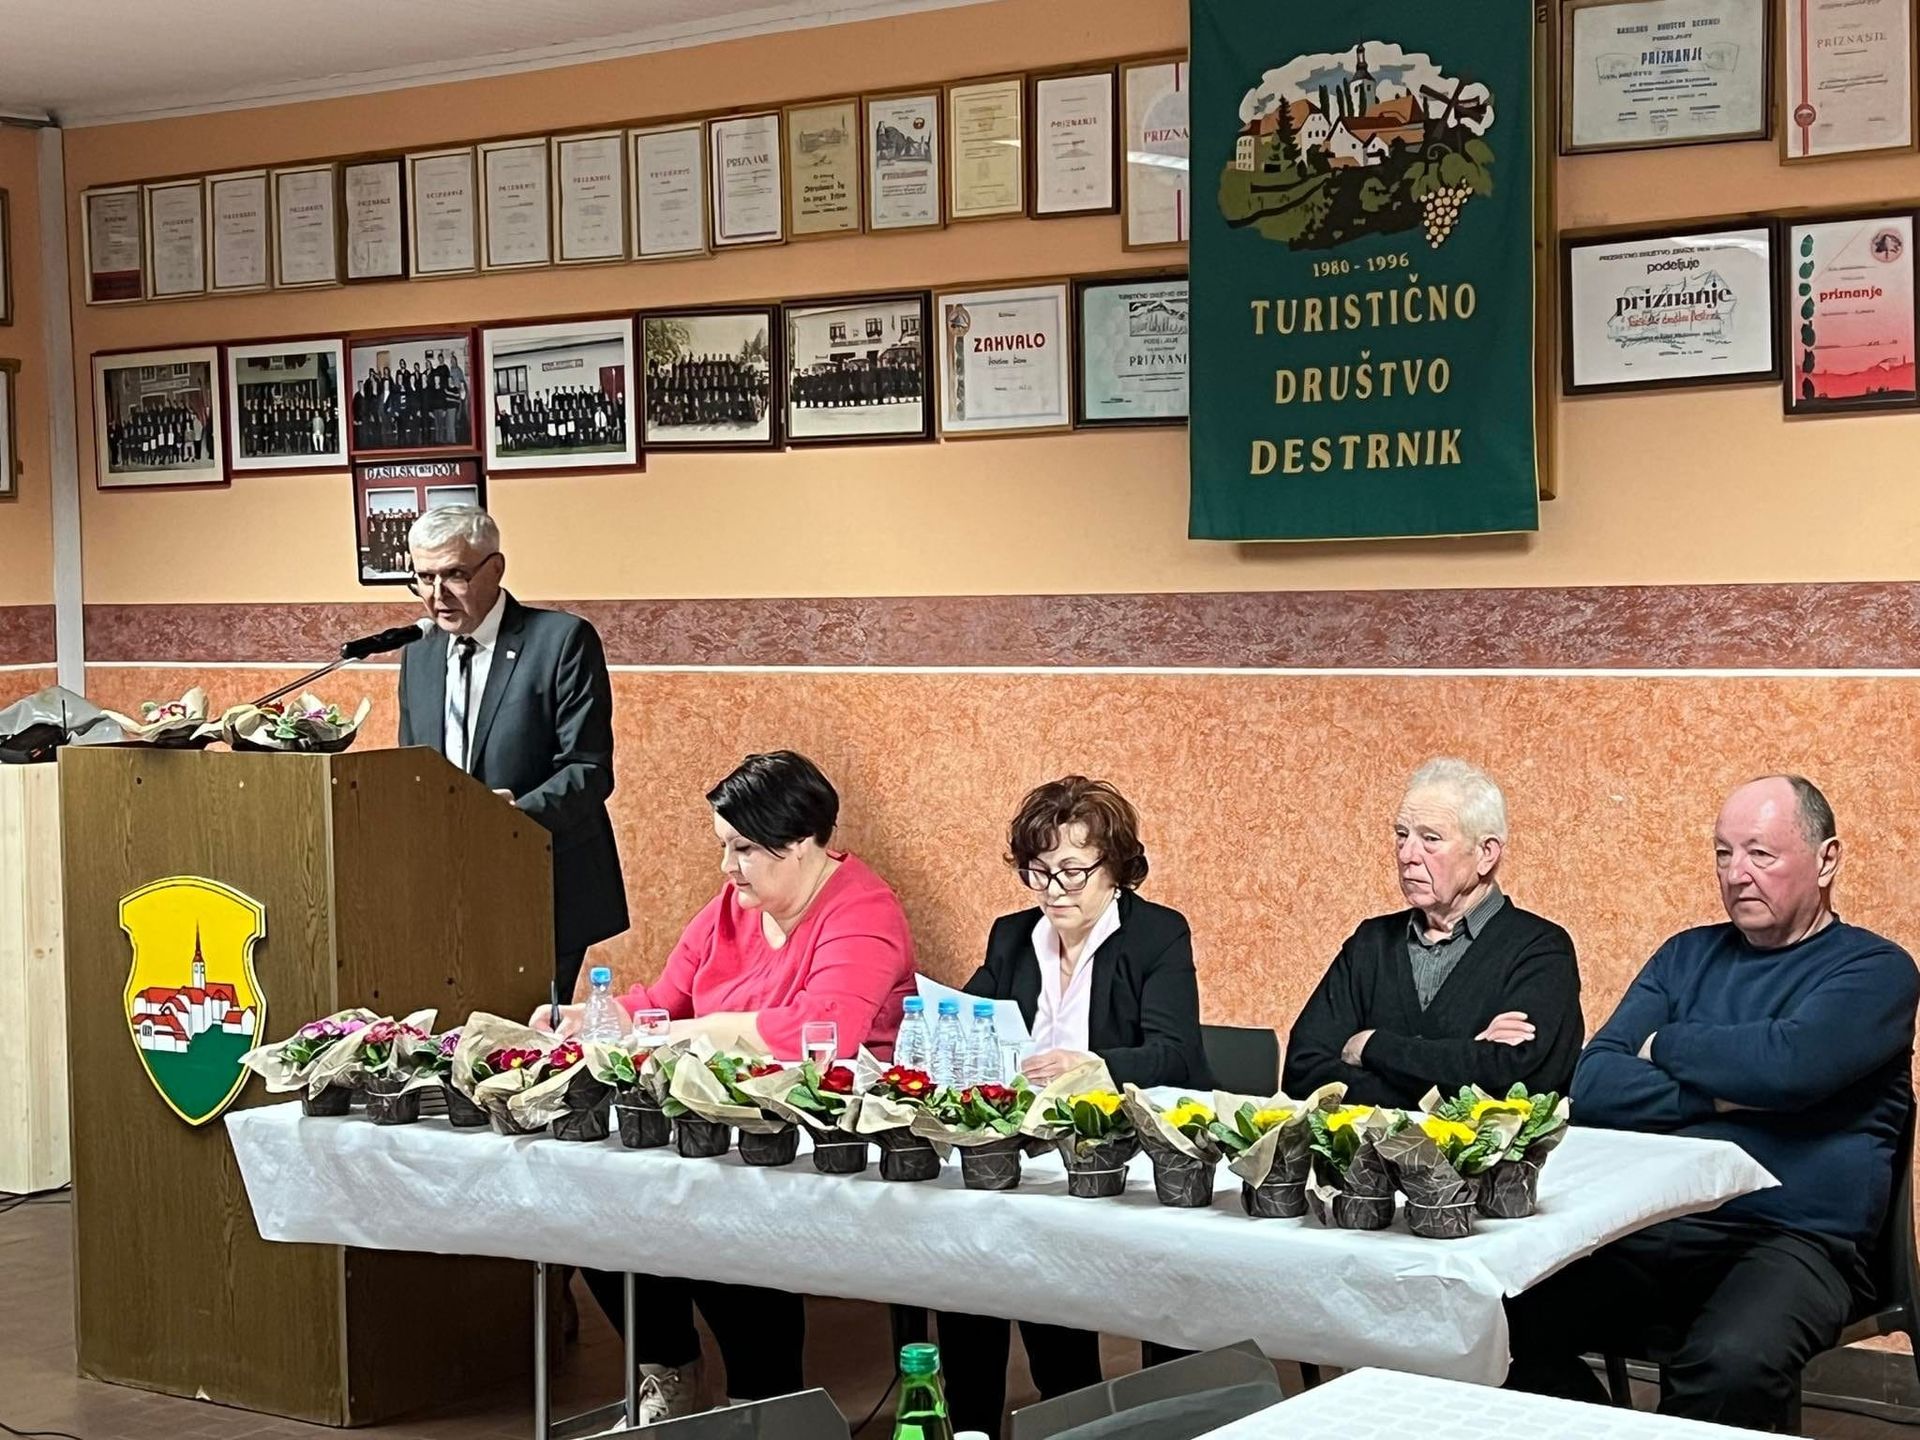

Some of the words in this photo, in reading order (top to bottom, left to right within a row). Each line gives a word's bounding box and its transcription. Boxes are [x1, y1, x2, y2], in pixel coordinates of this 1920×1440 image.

[1816, 31, 1888, 49] PRIZNANJE
[1641, 47, 1703, 66] PRIZNANJE
[1312, 258, 1350, 278] 1980
[1366, 252, 1410, 272] 1996
[1250, 272, 1477, 335] TURISTIČNO
[1616, 283, 1733, 317] priznanje
[1819, 286, 1883, 303] priznanje
[973, 332, 1046, 353] ZAHVALO
[1275, 350, 1450, 404] DRUŠTVO
[1250, 428, 1462, 475] DESTRNIK
